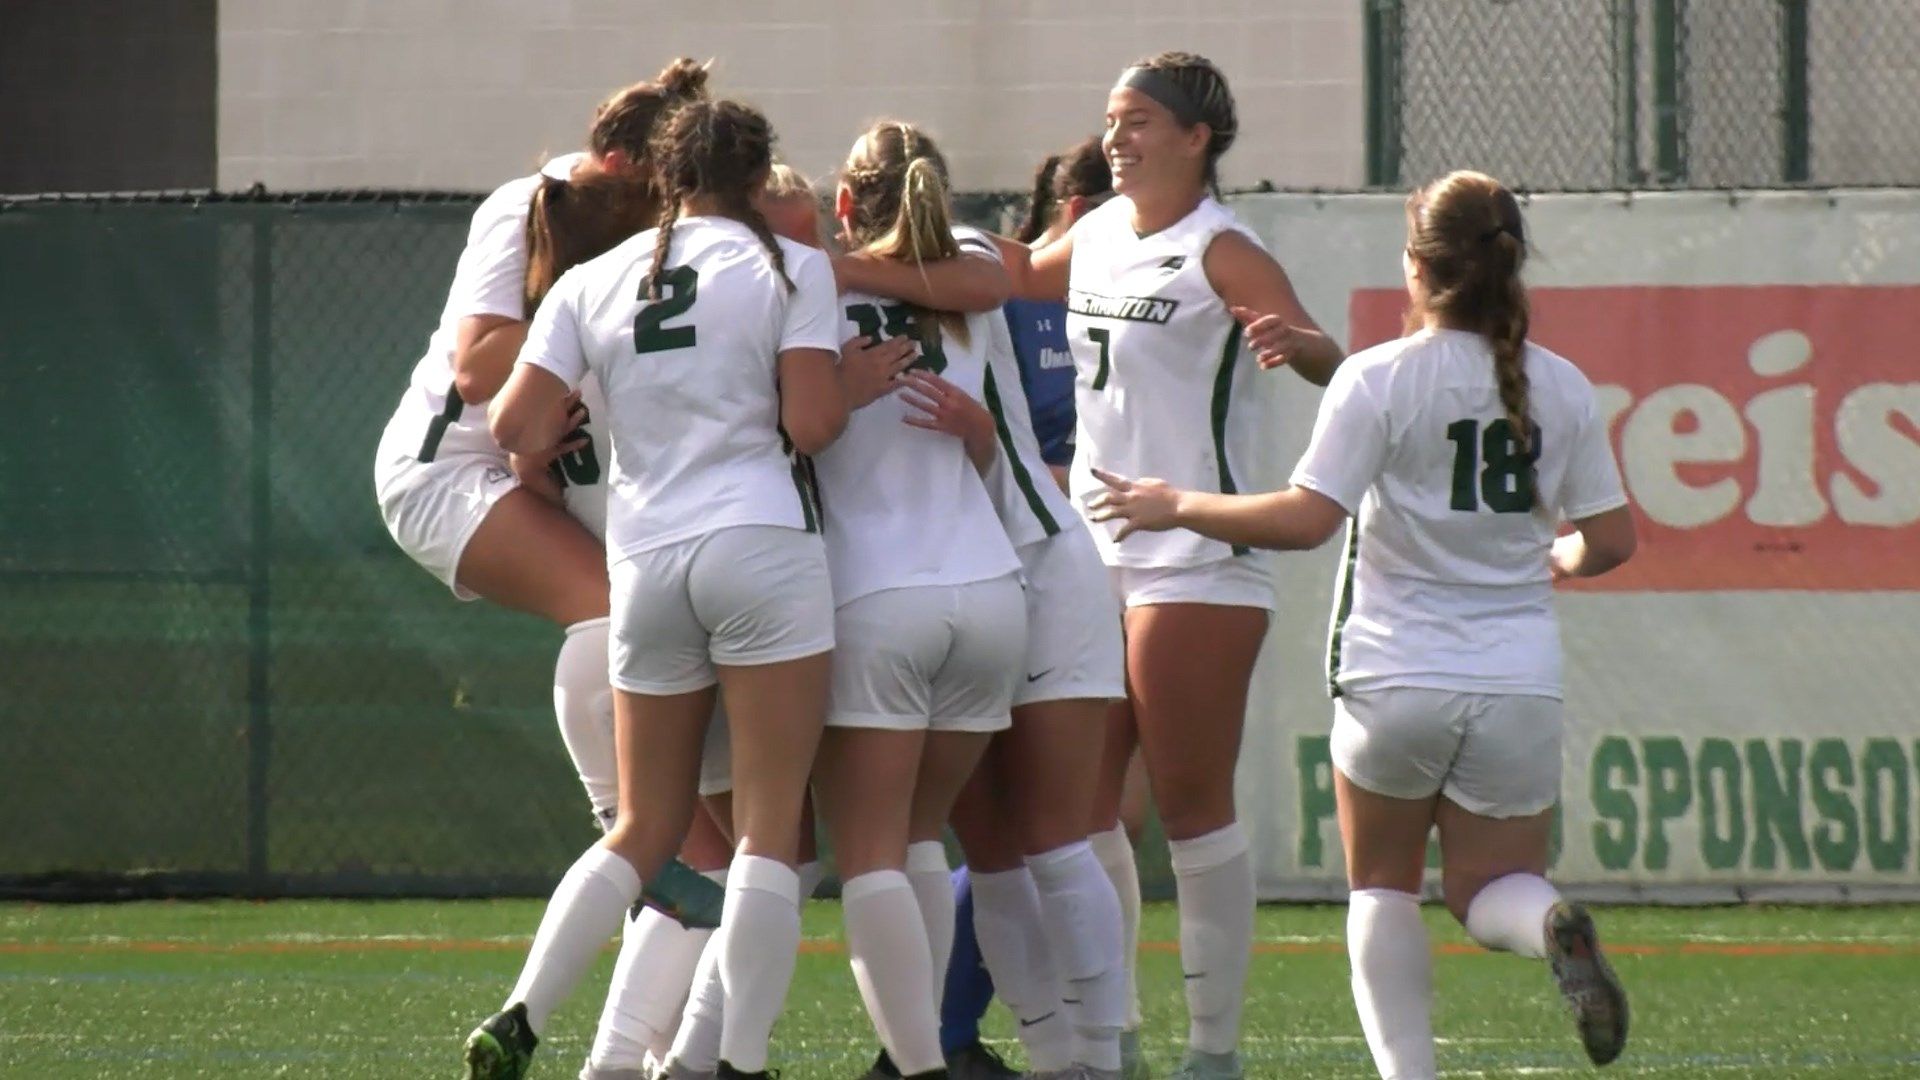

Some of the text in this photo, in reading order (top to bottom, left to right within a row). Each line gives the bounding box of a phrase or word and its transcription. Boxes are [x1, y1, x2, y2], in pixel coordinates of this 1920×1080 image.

[634, 264, 698, 354] 2
[1087, 326, 1110, 391] 7
[1446, 417, 1542, 513] 18
[1594, 328, 1920, 530] eis
[1591, 736, 1920, 871] SPONSO
